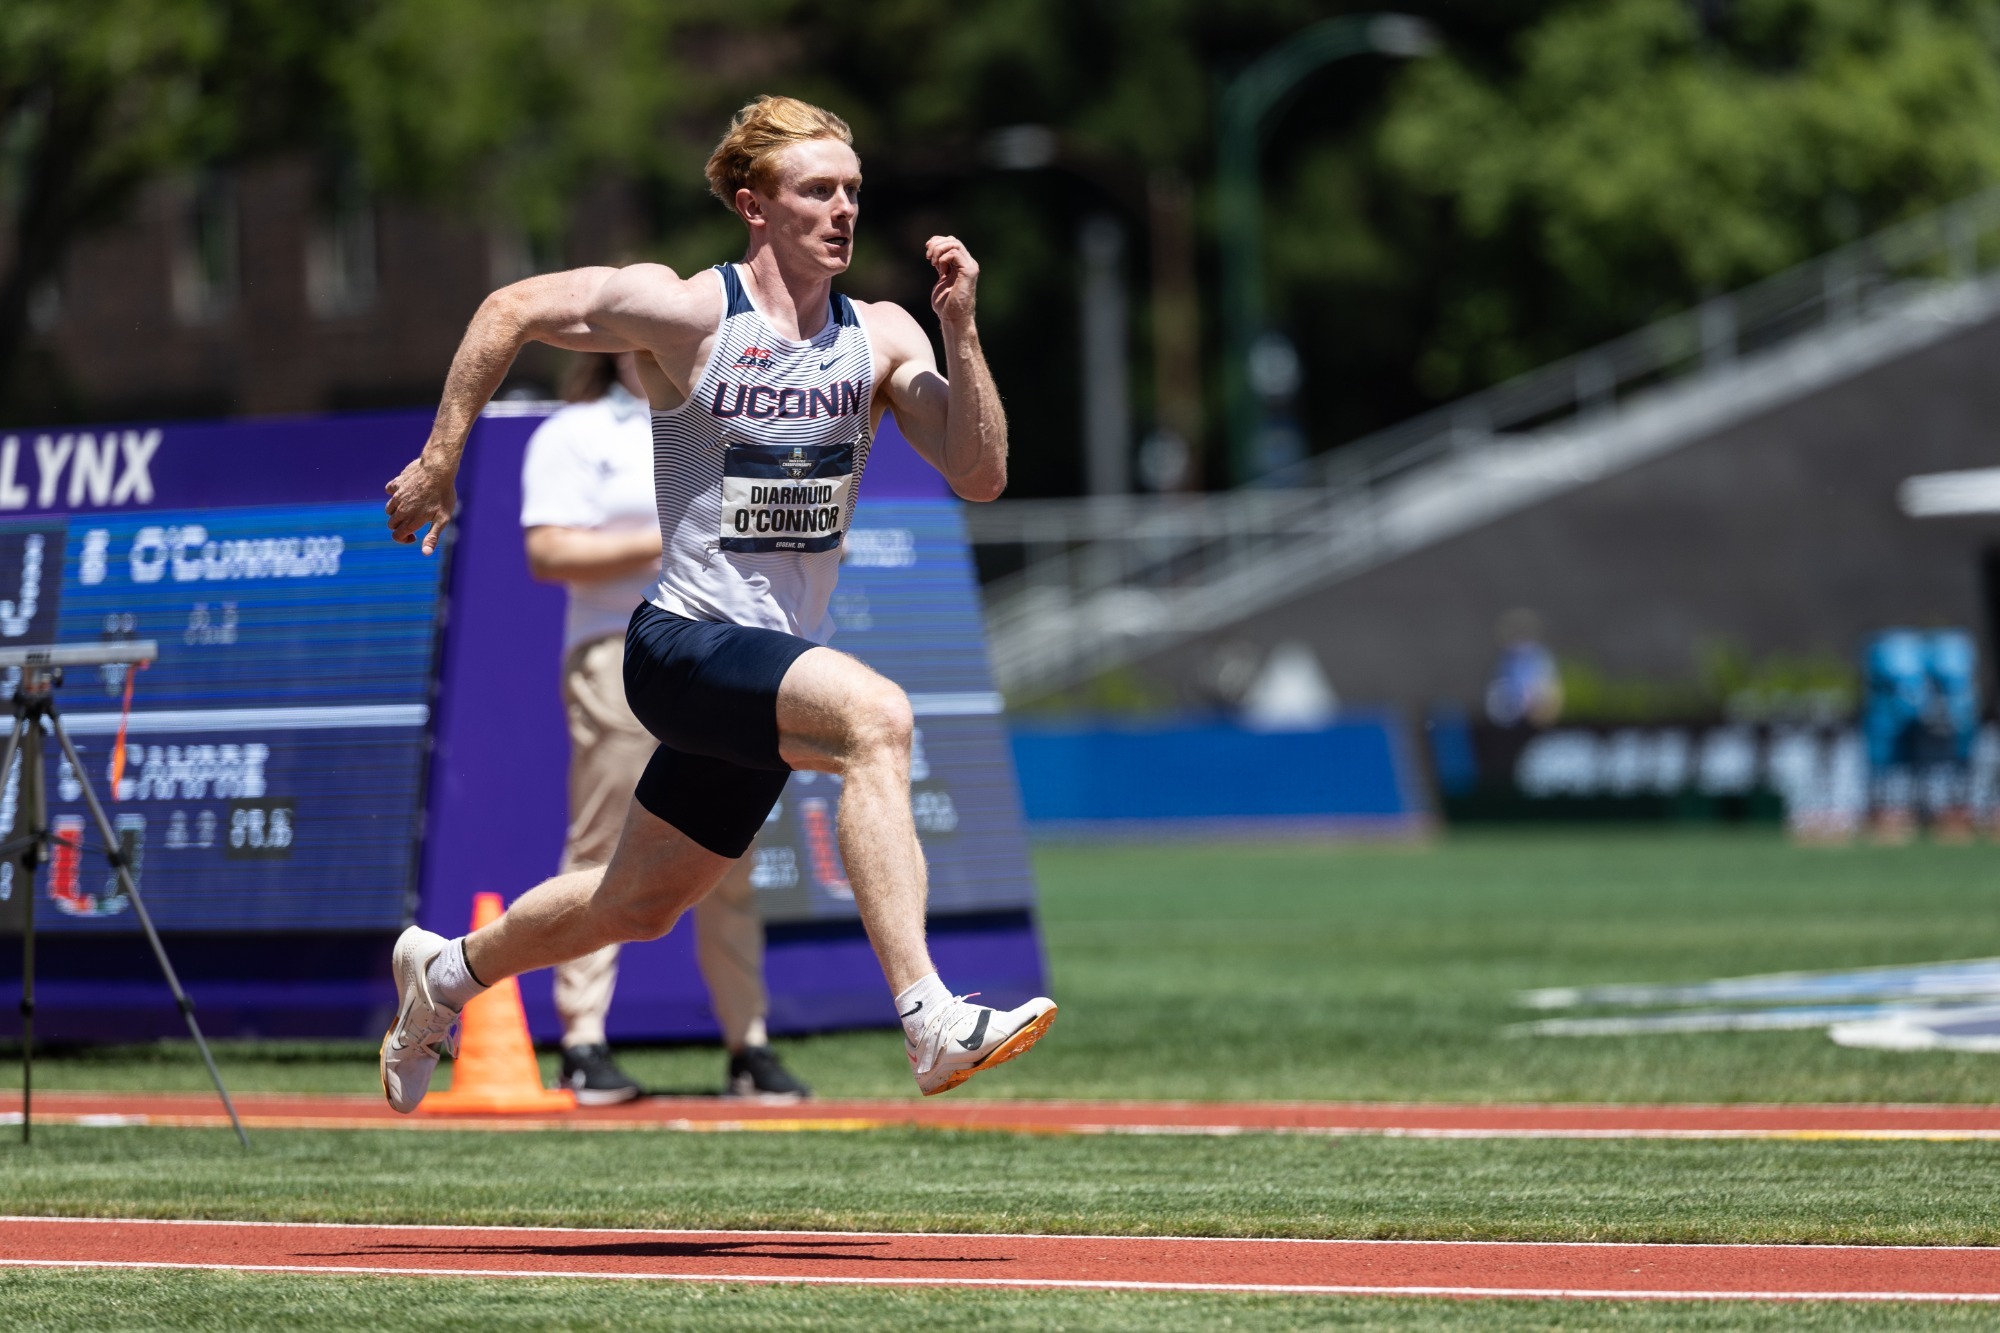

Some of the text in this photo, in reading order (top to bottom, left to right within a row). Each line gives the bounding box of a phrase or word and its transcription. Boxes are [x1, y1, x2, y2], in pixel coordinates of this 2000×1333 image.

[737, 356, 775, 368] EAST
[743, 347, 772, 359] BIG
[711, 379, 863, 419] UCONN
[0, 428, 163, 510] LYNX
[750, 485, 832, 505] DIARMUID
[734, 505, 839, 533] O'CONNOR
